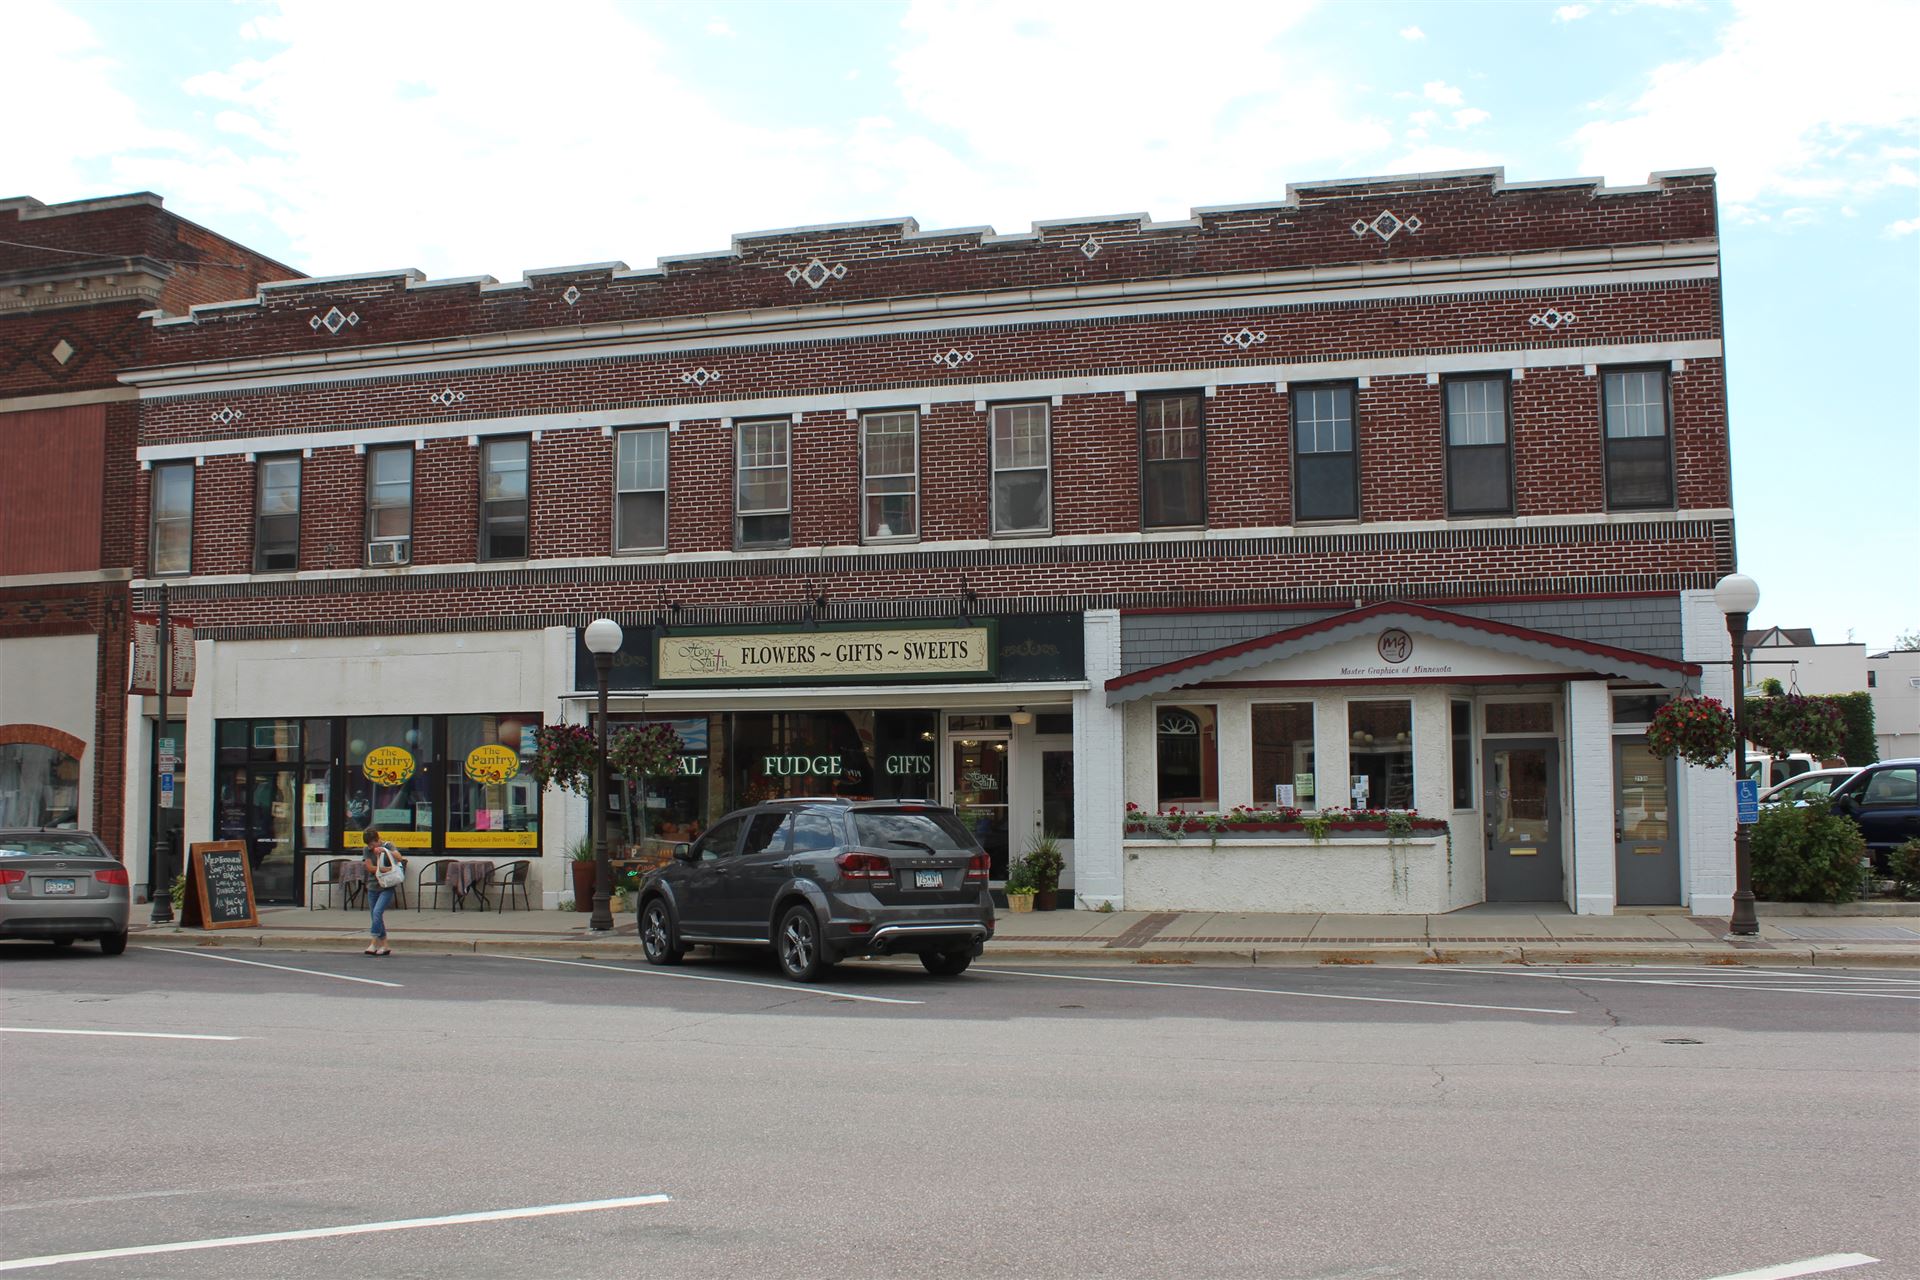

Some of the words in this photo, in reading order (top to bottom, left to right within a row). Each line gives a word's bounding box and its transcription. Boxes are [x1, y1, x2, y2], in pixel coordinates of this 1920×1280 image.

[741, 645, 816, 664] FLOWERS
[836, 643, 883, 662] GIFTS
[903, 640, 968, 661] SWEETS
[1340, 667, 1365, 675] Master
[1367, 666, 1399, 676] Graphics
[1402, 666, 1410, 674] of
[1412, 665, 1452, 674] Minnesota
[482, 747, 501, 755] The
[369, 756, 411, 767] Pantry
[471, 755, 514, 766] Pantry
[765, 755, 842, 775] FUDGE
[886, 755, 931, 774] GIFTS
